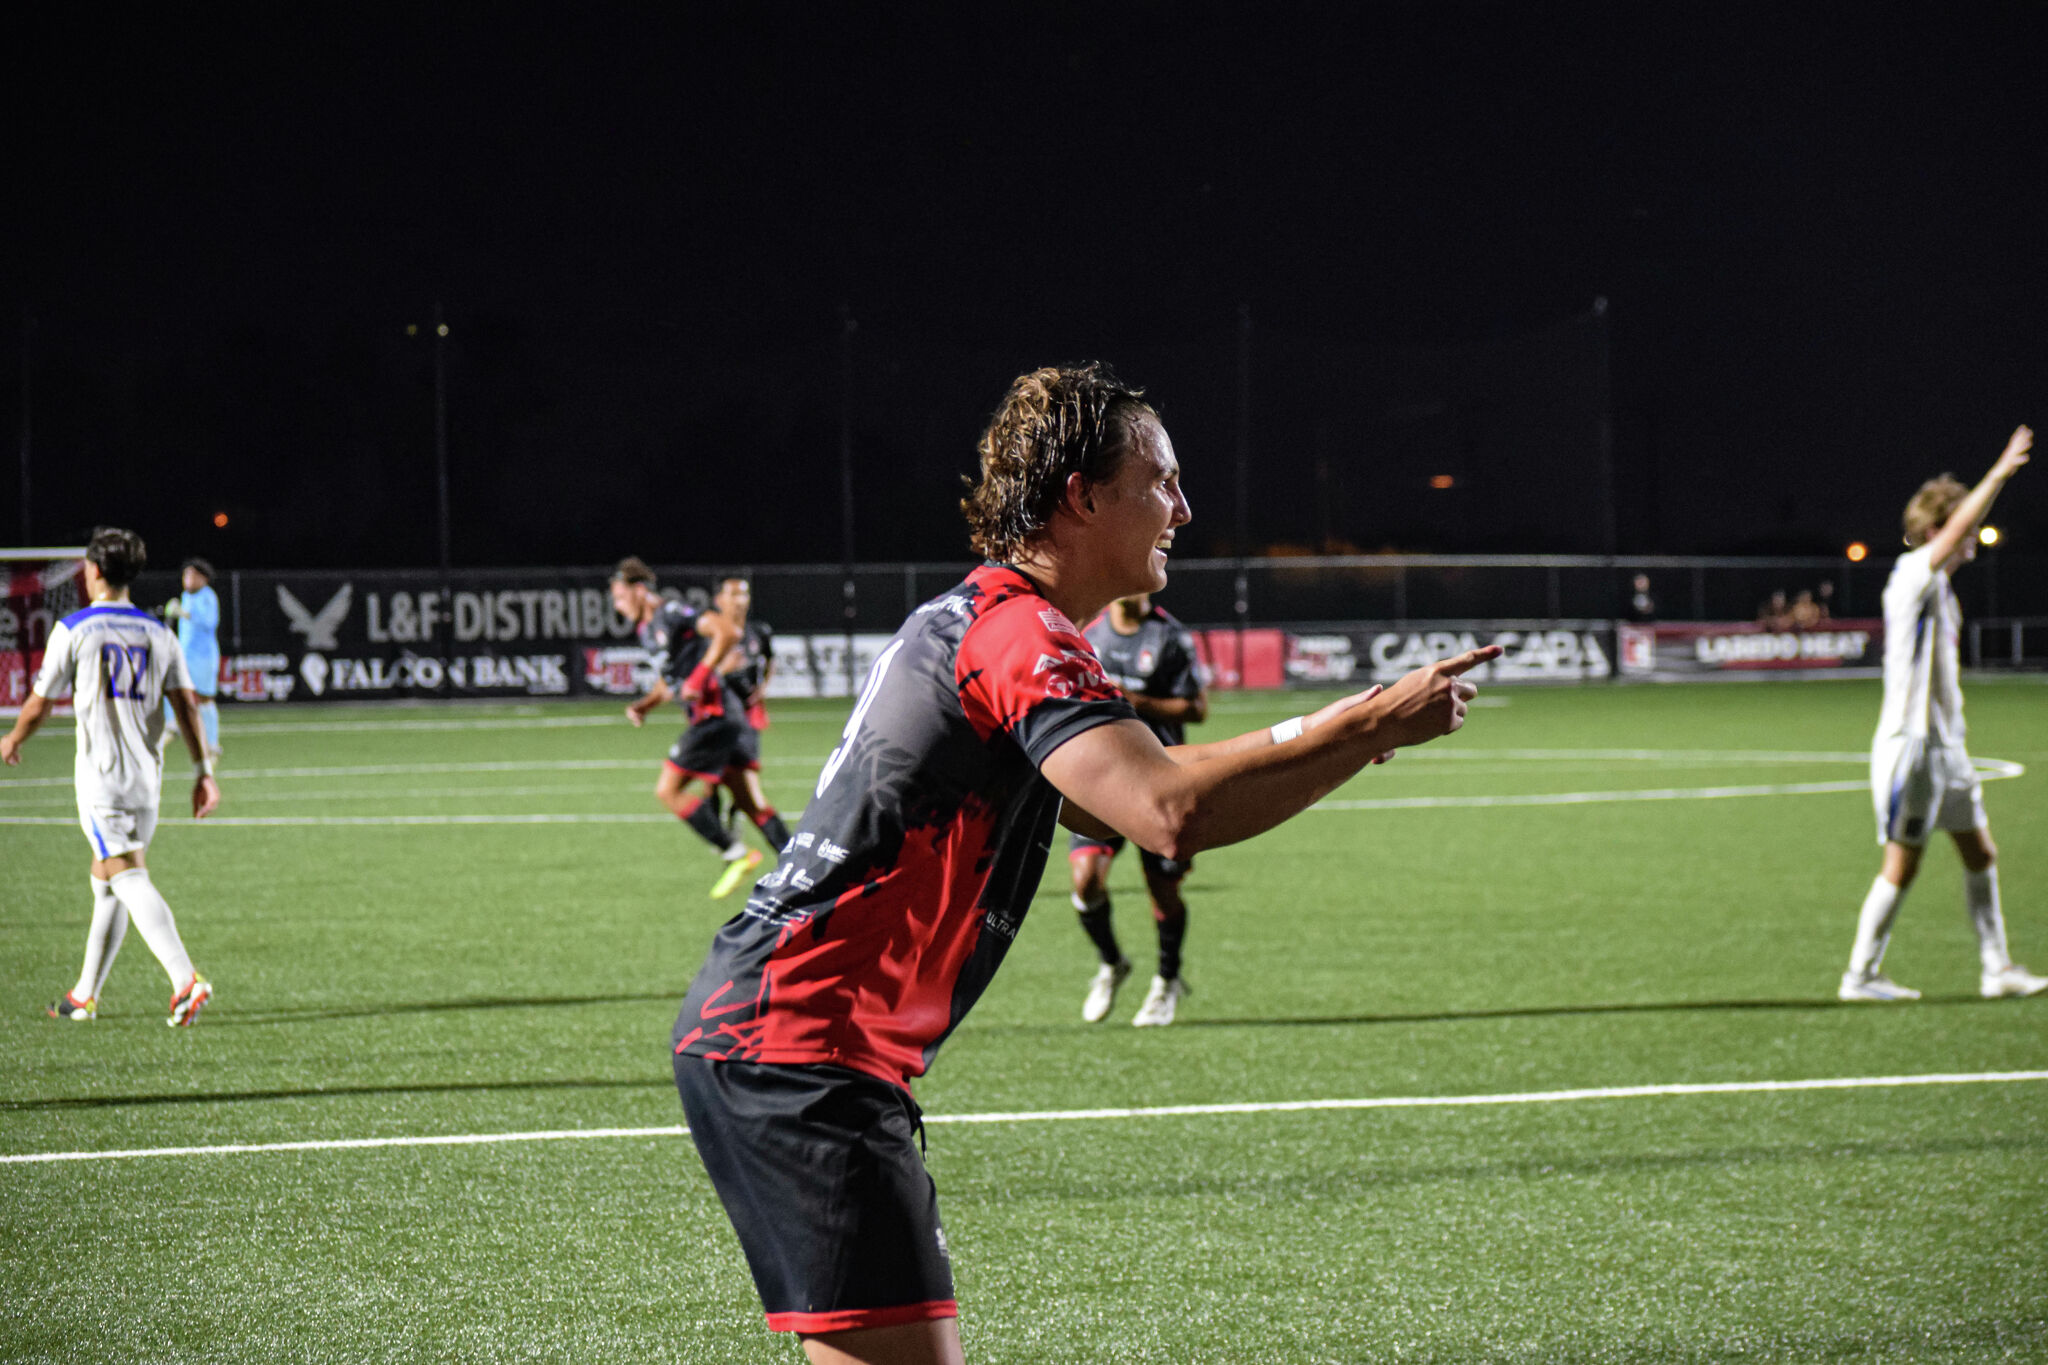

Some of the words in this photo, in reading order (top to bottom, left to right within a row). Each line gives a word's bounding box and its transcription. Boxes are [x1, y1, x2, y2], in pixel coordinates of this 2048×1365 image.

[367, 591, 440, 642] L&F
[454, 587, 712, 641] DISTRIBU
[103, 643, 148, 700] 22
[472, 655, 564, 687] BANK
[986, 911, 1016, 939] ULTRA
